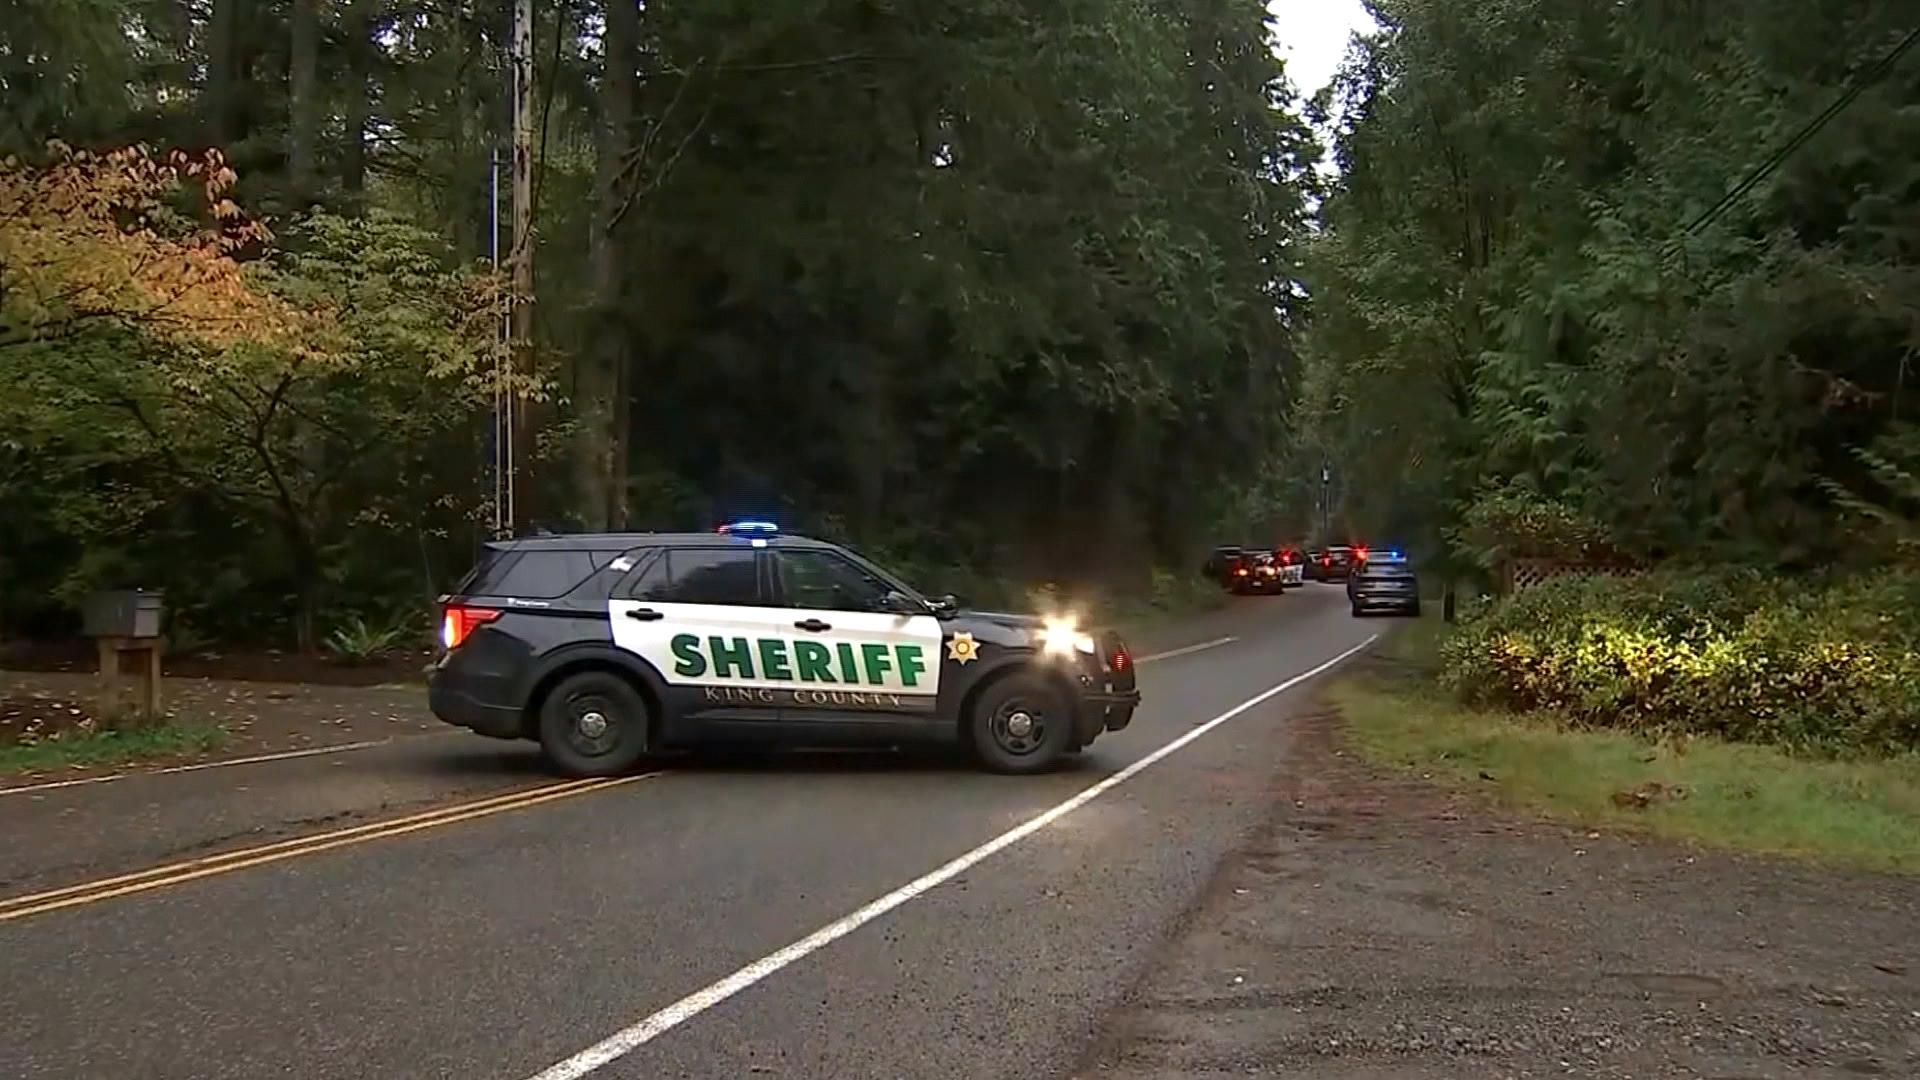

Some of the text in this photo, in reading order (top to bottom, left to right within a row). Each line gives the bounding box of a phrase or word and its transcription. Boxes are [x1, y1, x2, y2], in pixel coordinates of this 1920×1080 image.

[670, 633, 926, 686] SHERIFF
[704, 686, 901, 707] KING COUNTY
